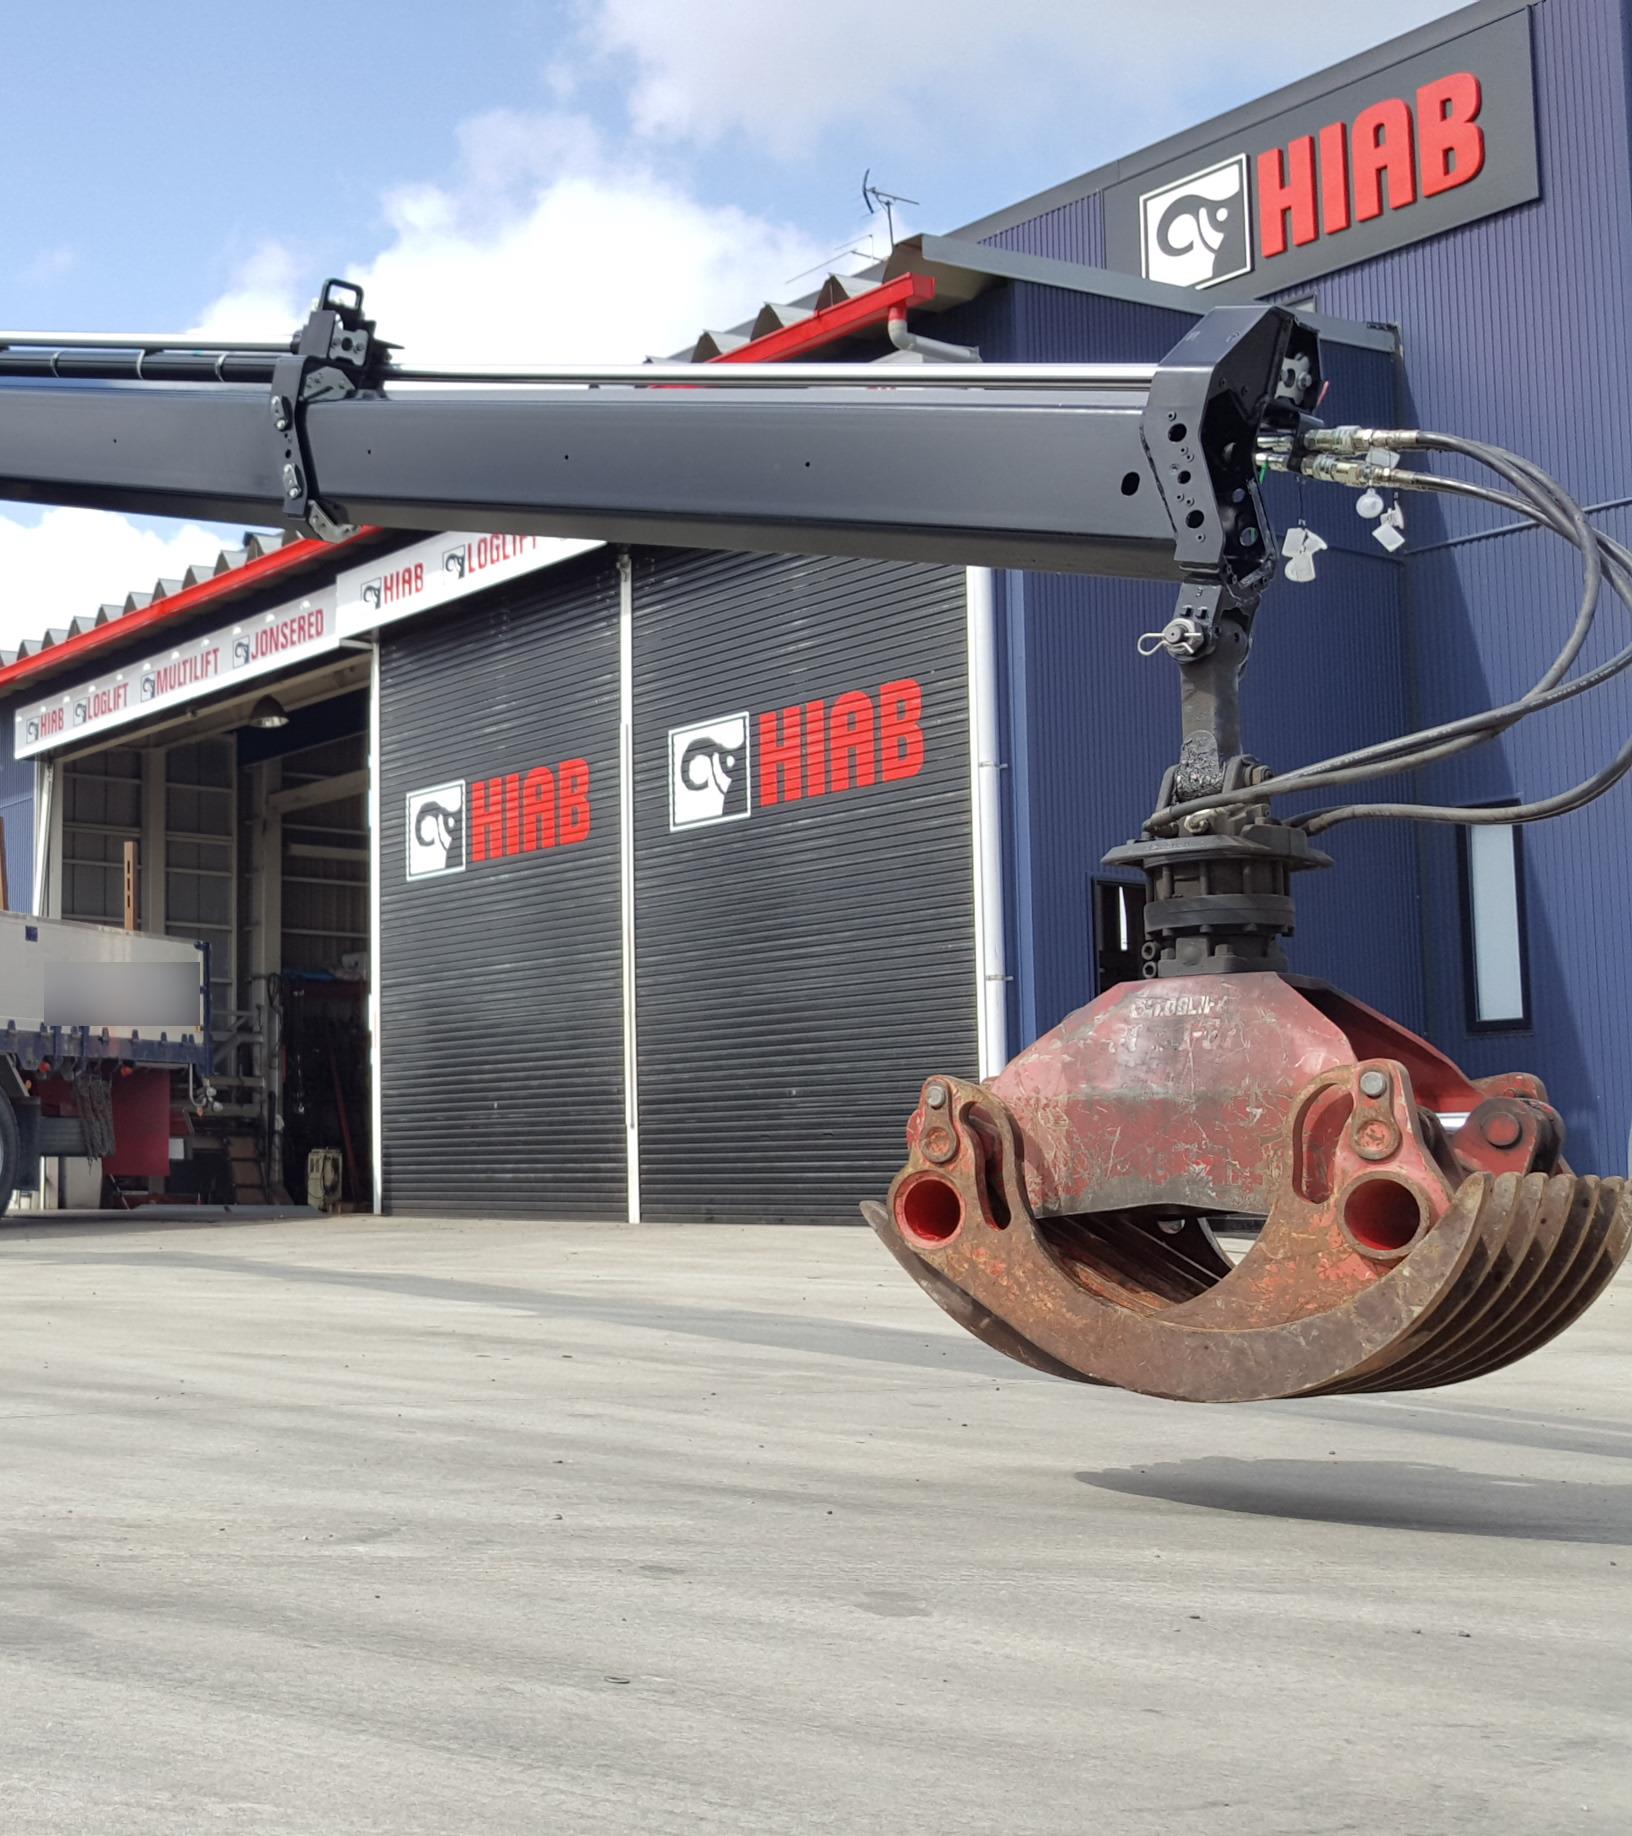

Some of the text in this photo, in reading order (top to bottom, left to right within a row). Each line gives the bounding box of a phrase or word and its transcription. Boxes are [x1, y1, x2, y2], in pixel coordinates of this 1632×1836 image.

[1257, 72, 1485, 258] HIAB
[383, 562, 424, 604] HIAB
[40, 607, 325, 737] HIAB LOGLIFT MULTILIFT JONSERED
[758, 678, 925, 808] HIAB
[470, 757, 592, 863] HIAB
